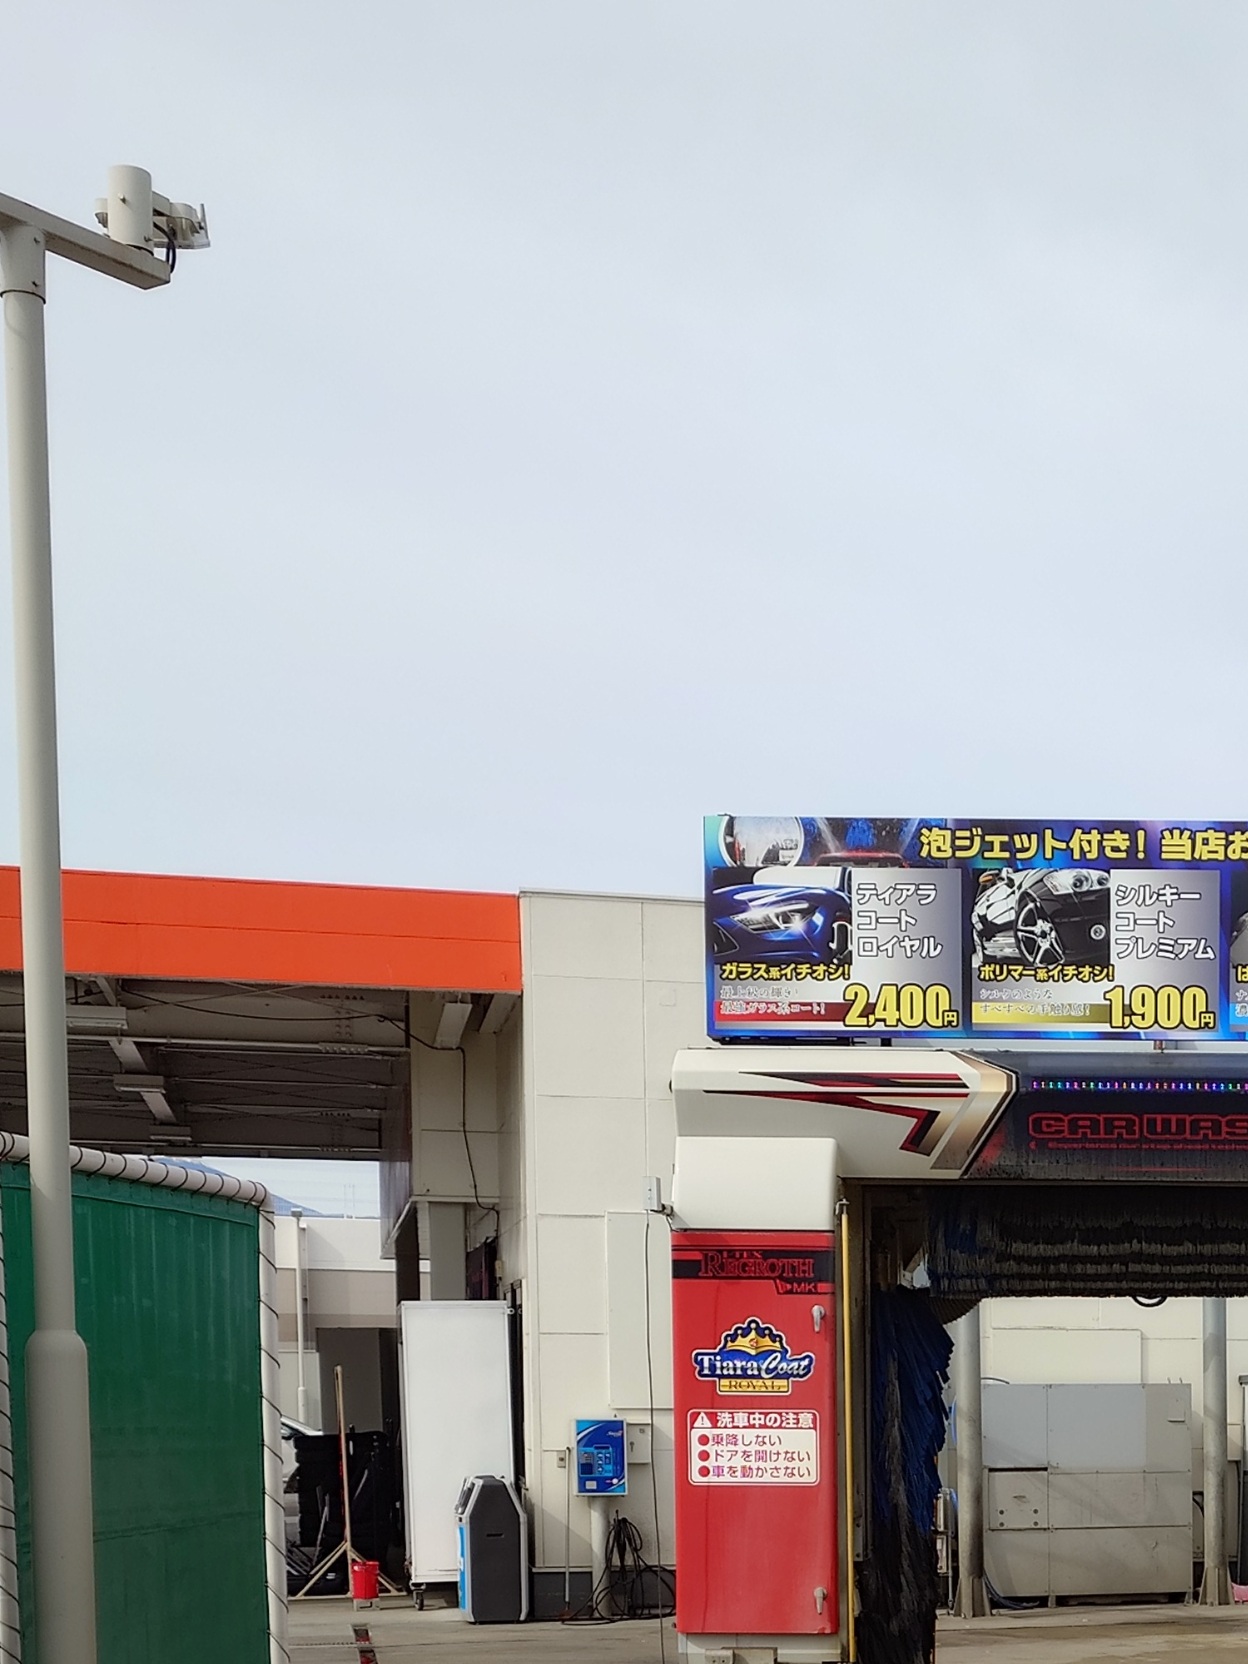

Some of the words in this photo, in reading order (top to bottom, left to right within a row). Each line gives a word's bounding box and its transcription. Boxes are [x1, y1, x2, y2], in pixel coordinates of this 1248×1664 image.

[856, 882, 937, 905] ティアラ
[1115, 884, 1201, 908] シルキー
[856, 910, 917, 932] コート
[1115, 912, 1175, 933] コート
[857, 936, 943, 960] ロイヤル
[1114, 936, 1216, 962] プレミアム
[720, 962, 851, 981] ガラス系イチオシ!
[978, 964, 1116, 982] ポリマー系イチオシ!
[843, 983, 959, 1029] 2,400円
[1103, 984, 1215, 1030] 1,900円
[1029, 1112, 1139, 1139] CAR
[697, 1355, 759, 1376] Tiara
[760, 1352, 810, 1378] Coat
[727, 1379, 782, 1391] ROYAL
[716, 1412, 814, 1429] 洗車中の注意
[711, 1433, 782, 1448] 乗降しない
[713, 1448, 811, 1463] ドアを開けない
[711, 1464, 811, 1479] 車を動かさない
